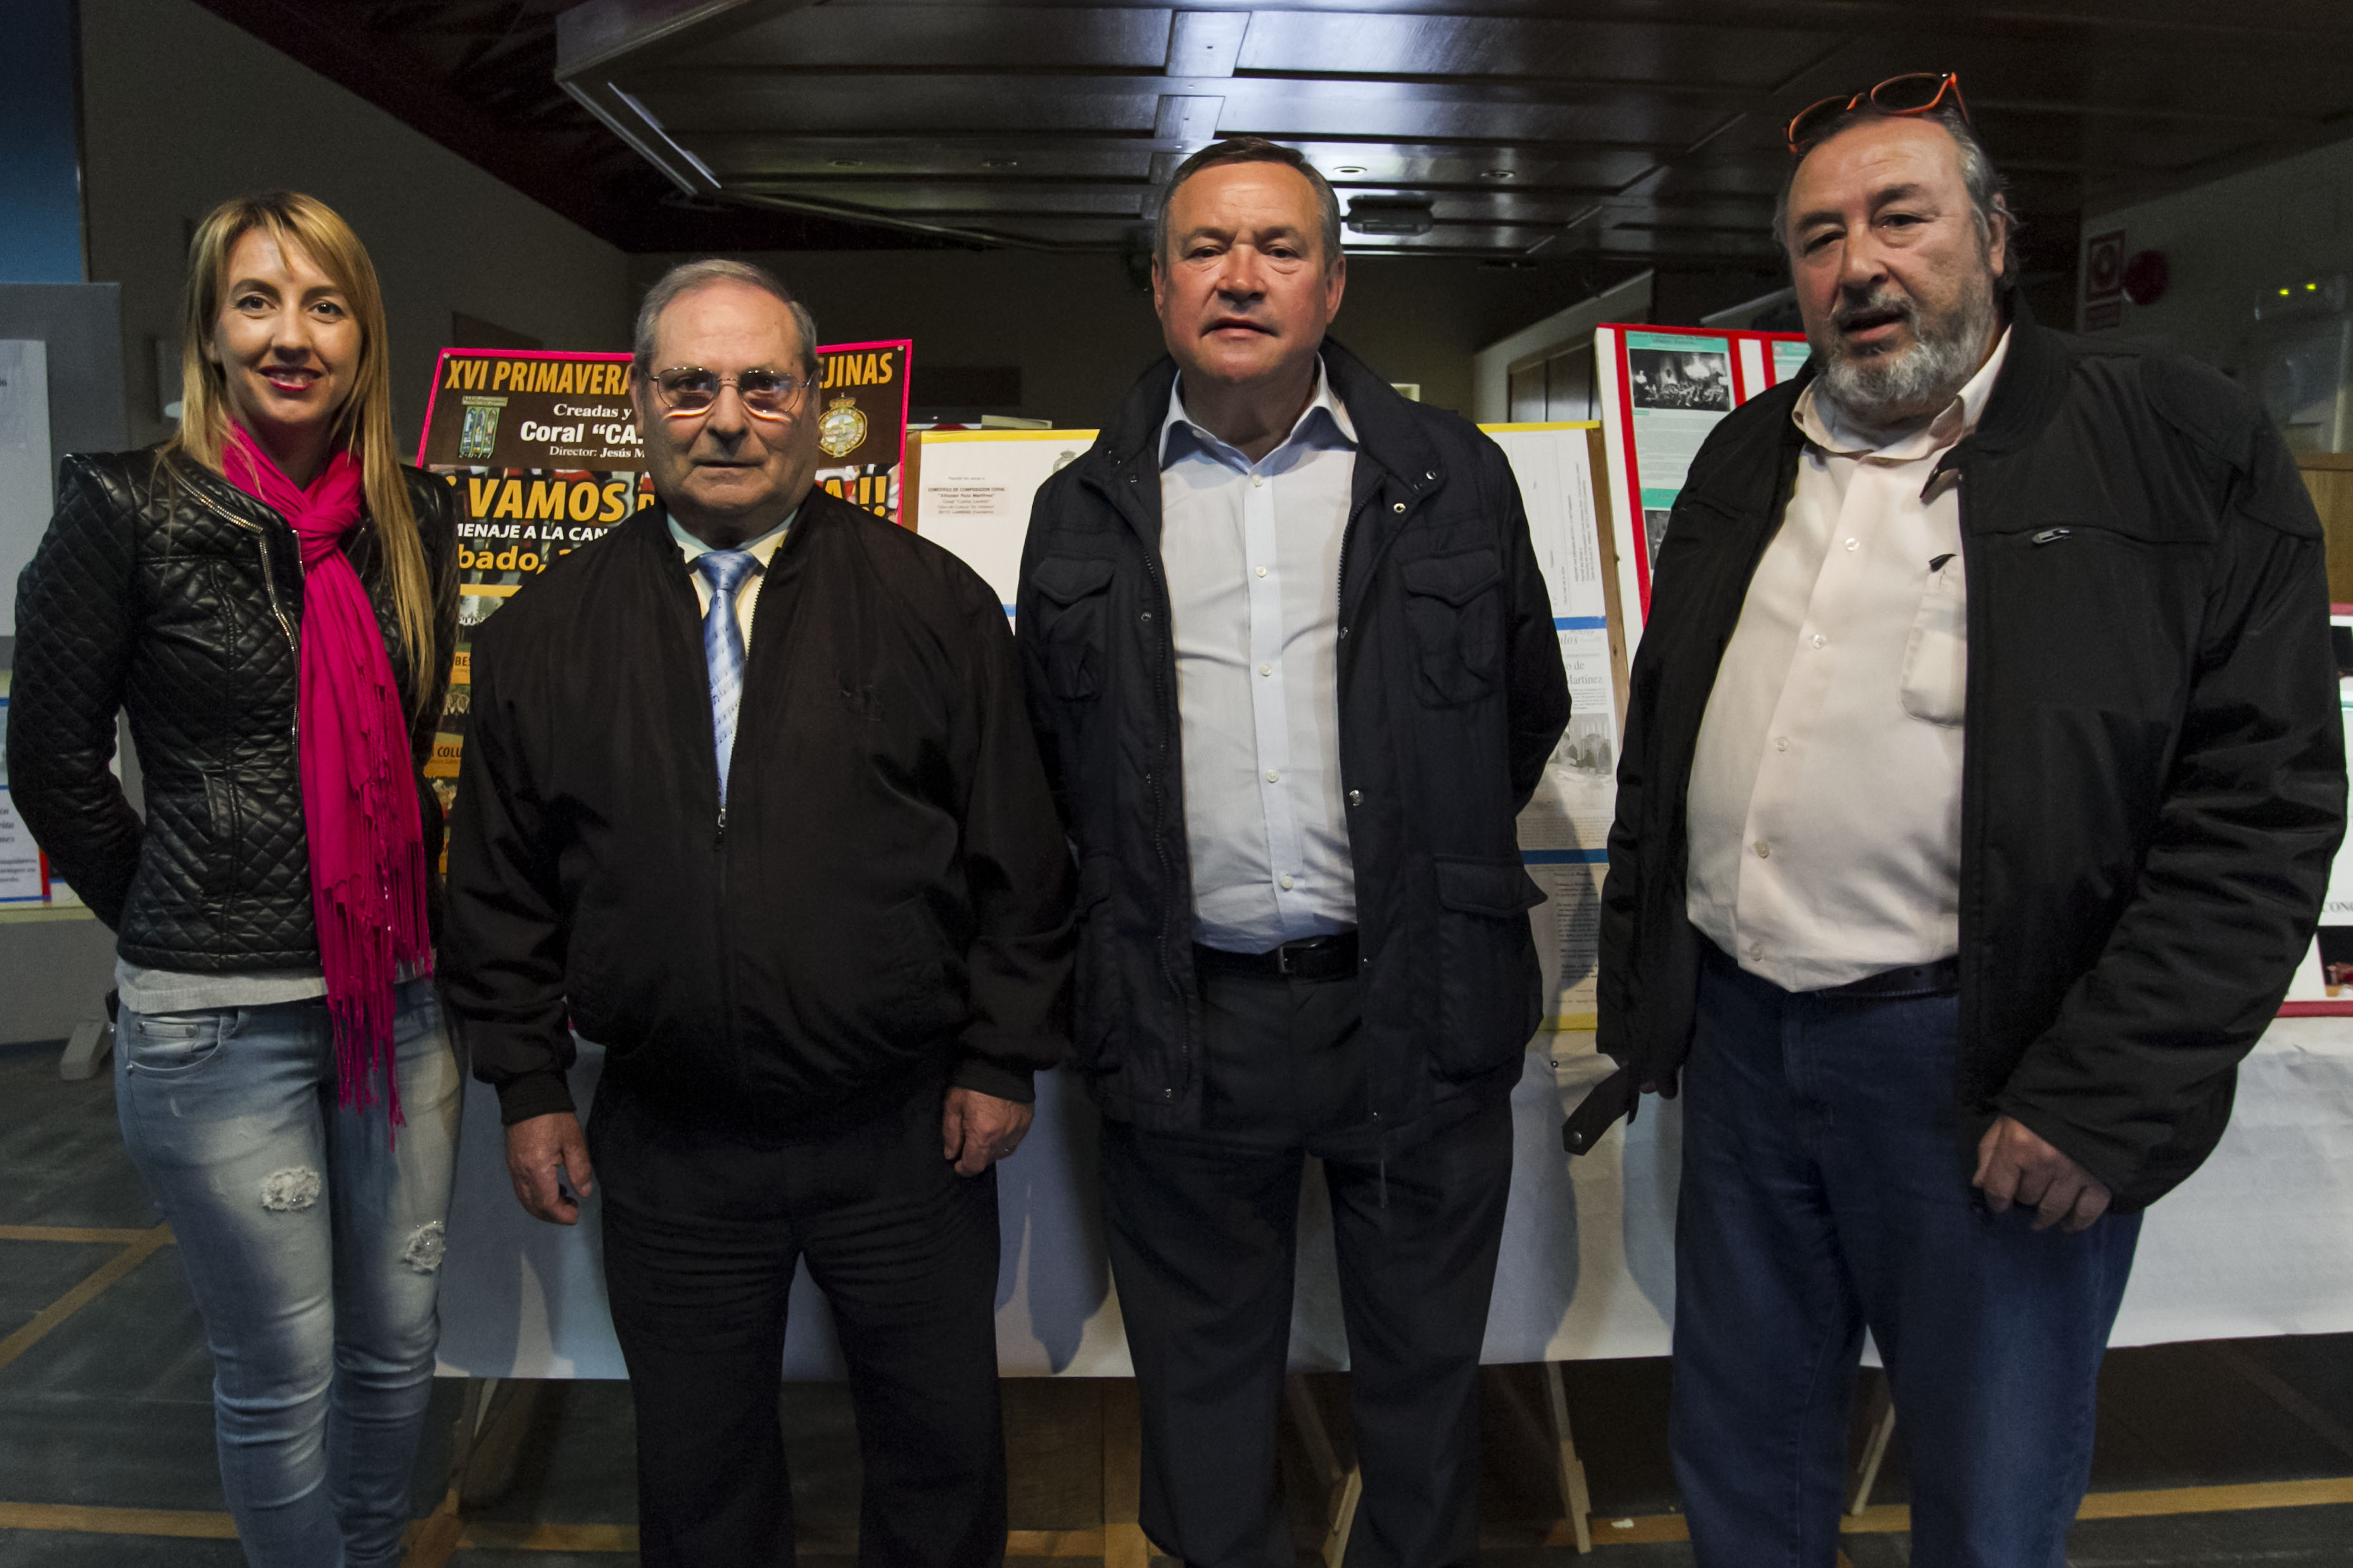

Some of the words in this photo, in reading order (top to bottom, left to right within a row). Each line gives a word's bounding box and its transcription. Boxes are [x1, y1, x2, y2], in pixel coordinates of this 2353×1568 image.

[445, 360, 489, 390] XVI
[817, 353, 893, 389] JINAS
[553, 403, 619, 418] Creadas
[621, 408, 633, 421] y
[521, 421, 585, 443] Coral
[549, 446, 597, 457] Director:
[600, 446, 631, 458] Jesús
[469, 478, 626, 522] VAMOS
[457, 523, 521, 539] ENAJE
[523, 526, 536, 539] A
[541, 526, 564, 540] LA
[569, 527, 608, 541] CAN
[458, 543, 547, 575] bado,
